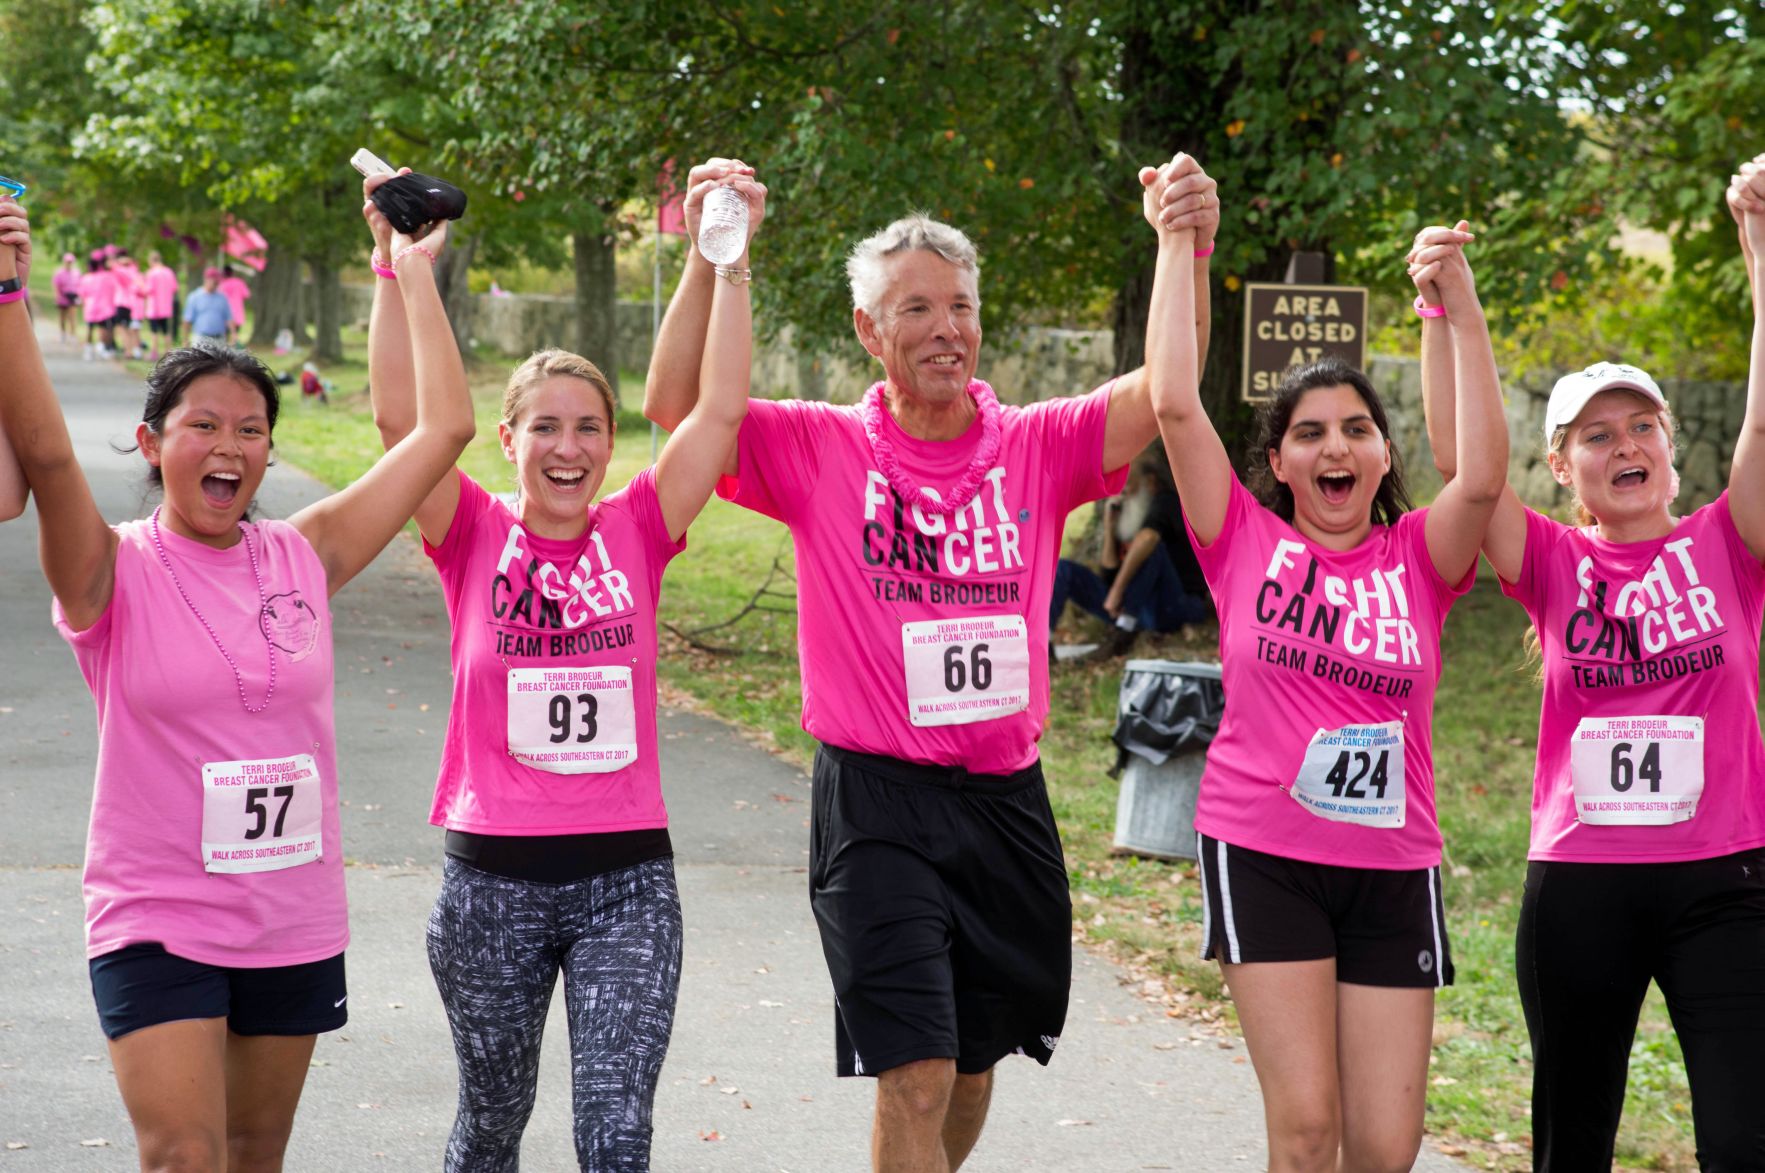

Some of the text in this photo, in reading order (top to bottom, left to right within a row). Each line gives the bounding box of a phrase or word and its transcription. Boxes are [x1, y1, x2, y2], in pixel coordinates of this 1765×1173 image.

[1273, 295, 1341, 317] AREA
[1257, 320, 1356, 342] CLOSED
[1289, 346, 1323, 366] AT
[863, 522, 1024, 576] CANCER
[492, 570, 634, 629] CANCER
[872, 577, 1020, 605] TEAM BRODEUR
[937, 621, 994, 633] TERRI BRODEUR
[1256, 580, 1422, 666] CANCER
[1565, 586, 1725, 661] CANCER
[496, 624, 635, 657] TEAM BRODEUR
[912, 629, 1020, 645] BREAST CANCER FOUNDATION
[544, 671, 603, 681] TERRI BRODEUR
[944, 643, 992, 693] 66
[1257, 636, 1413, 698] TEAM BRODEUR
[1571, 644, 1725, 688] TEAM BRODEUR
[517, 680, 628, 692] BREAST CANCER FOUNDATION
[918, 704, 934, 713] WALK
[935, 702, 957, 712] ACROSS
[958, 698, 1000, 710] SOUTHEASTERN
[549, 693, 598, 744] 93
[1608, 720, 1668, 730] TERRI BRODEUR
[1340, 728, 1360, 737] TERRI
[1343, 736, 1371, 747] CANCER
[1581, 730, 1695, 740] BREAST CANCER FOUNDATION
[536, 753, 559, 762] ACROSS
[560, 751, 605, 761] SOUTHEASTERN
[606, 751, 613, 759] CT
[614, 750, 629, 759] 2017
[242, 764, 265, 775] TERRI
[1325, 750, 1389, 799] 424
[1610, 742, 1662, 792] 64
[214, 776, 246, 786] BREAST
[248, 774, 279, 785] CANCER
[244, 785, 294, 840] 57
[1583, 802, 1597, 811] WALK
[1599, 802, 1621, 811] ACROSS
[1623, 802, 1669, 811] SOUTHEASTERN
[1671, 802, 1678, 811] CT
[212, 850, 229, 860] WALK
[231, 849, 254, 860] ACROSS
[255, 844, 296, 858] SOUTHEASTERN
[296, 844, 303, 853] CT
